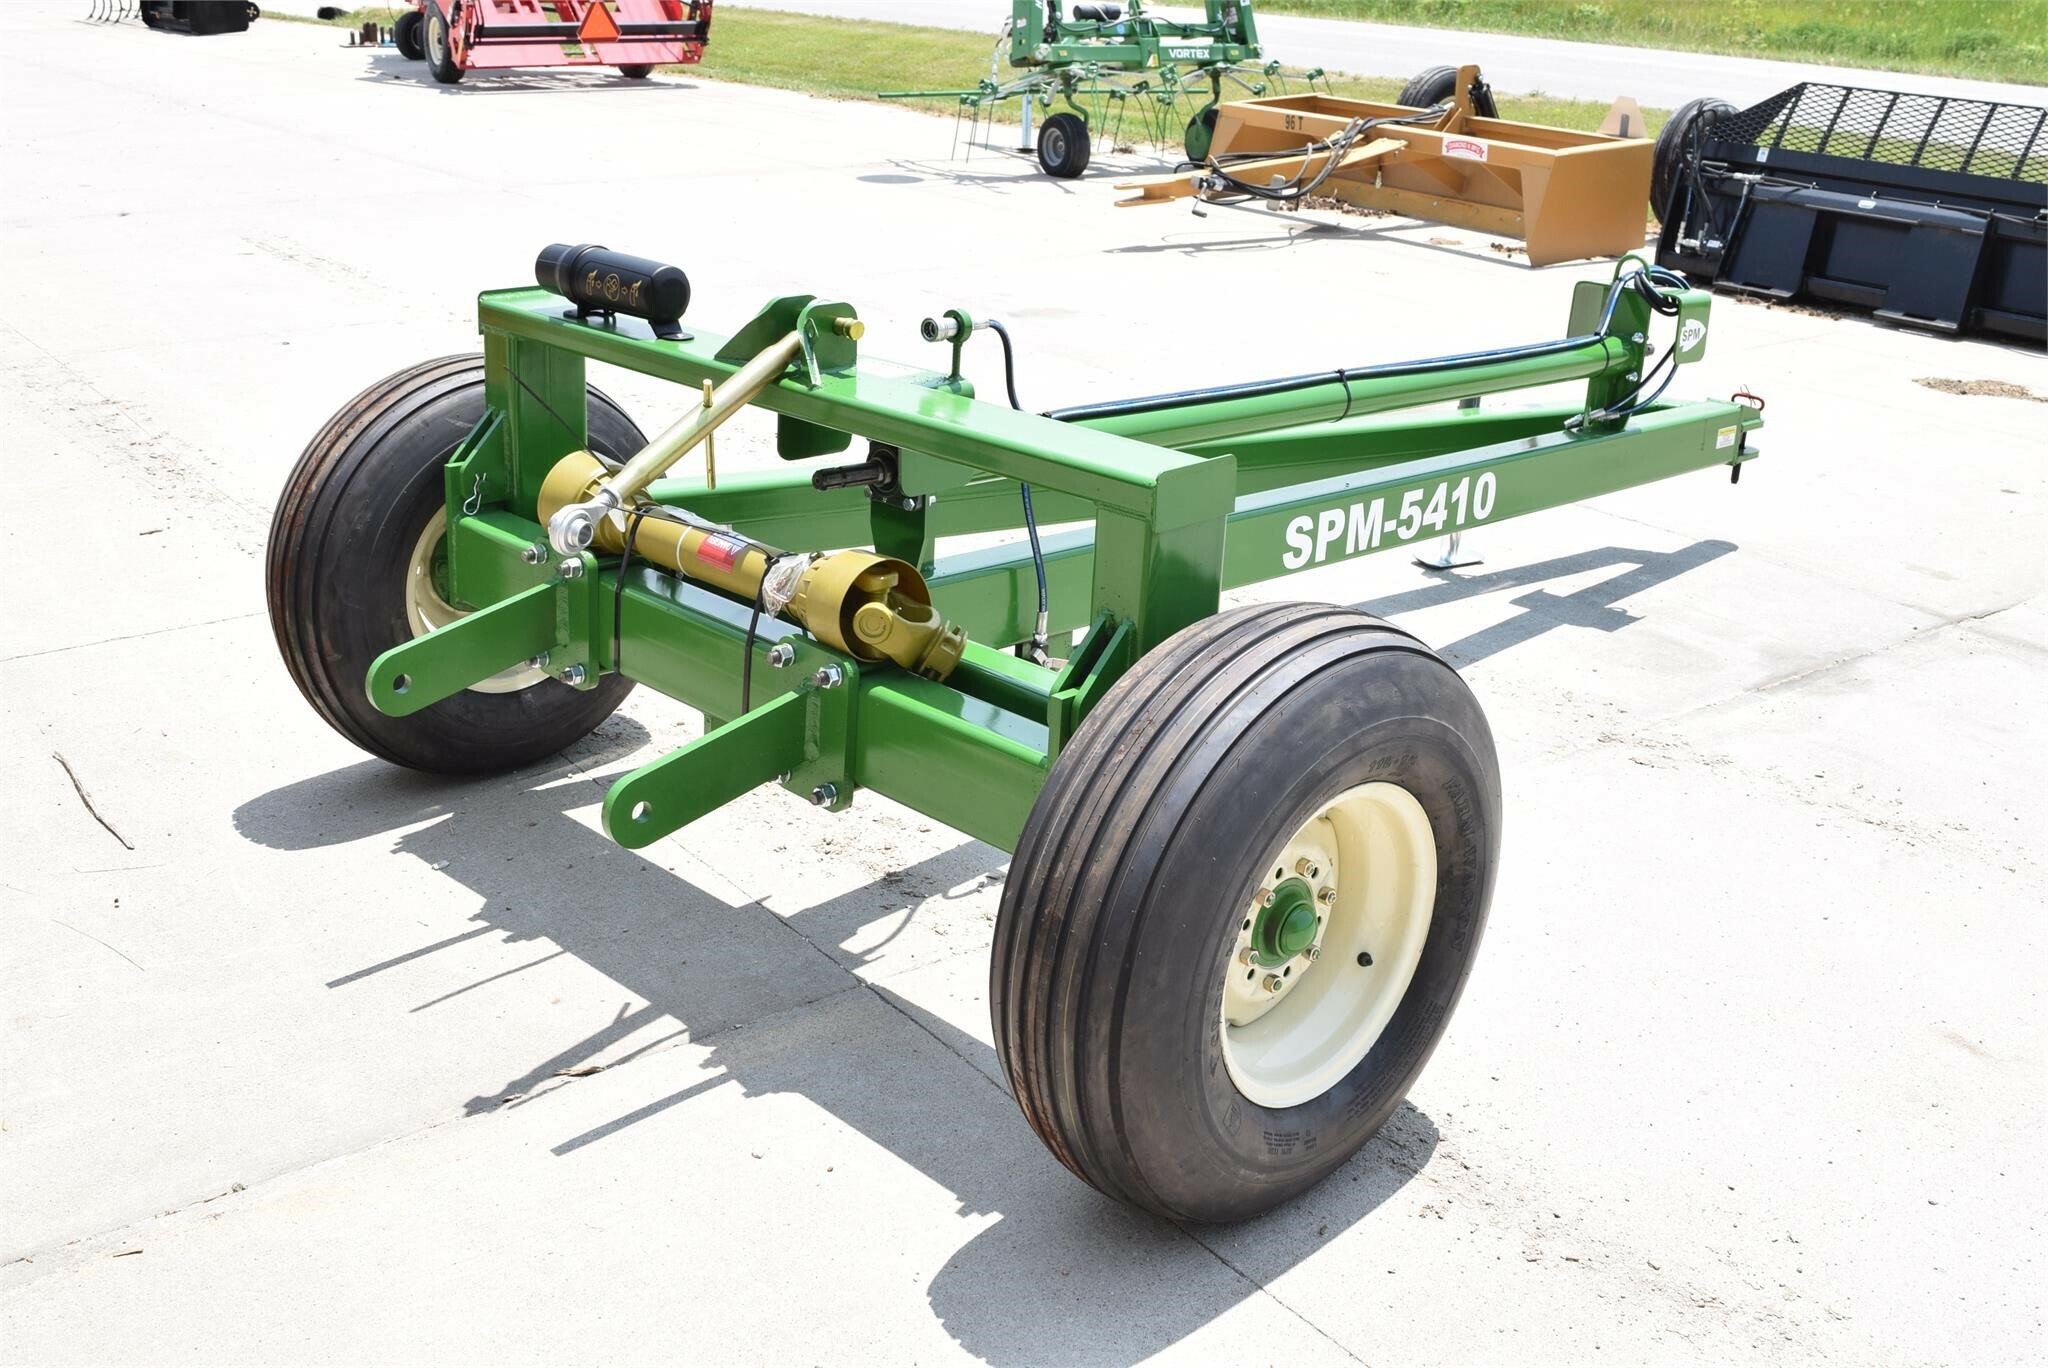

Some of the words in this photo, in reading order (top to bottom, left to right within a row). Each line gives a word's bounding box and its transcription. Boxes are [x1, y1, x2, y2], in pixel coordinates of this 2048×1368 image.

[1169, 49, 1209, 58] VORTEX
[1285, 114, 1295, 130] 96
[1298, 116, 1303, 130] T
[1682, 328, 1700, 342] SPM
[1282, 471, 1496, 569] SPM-5410
